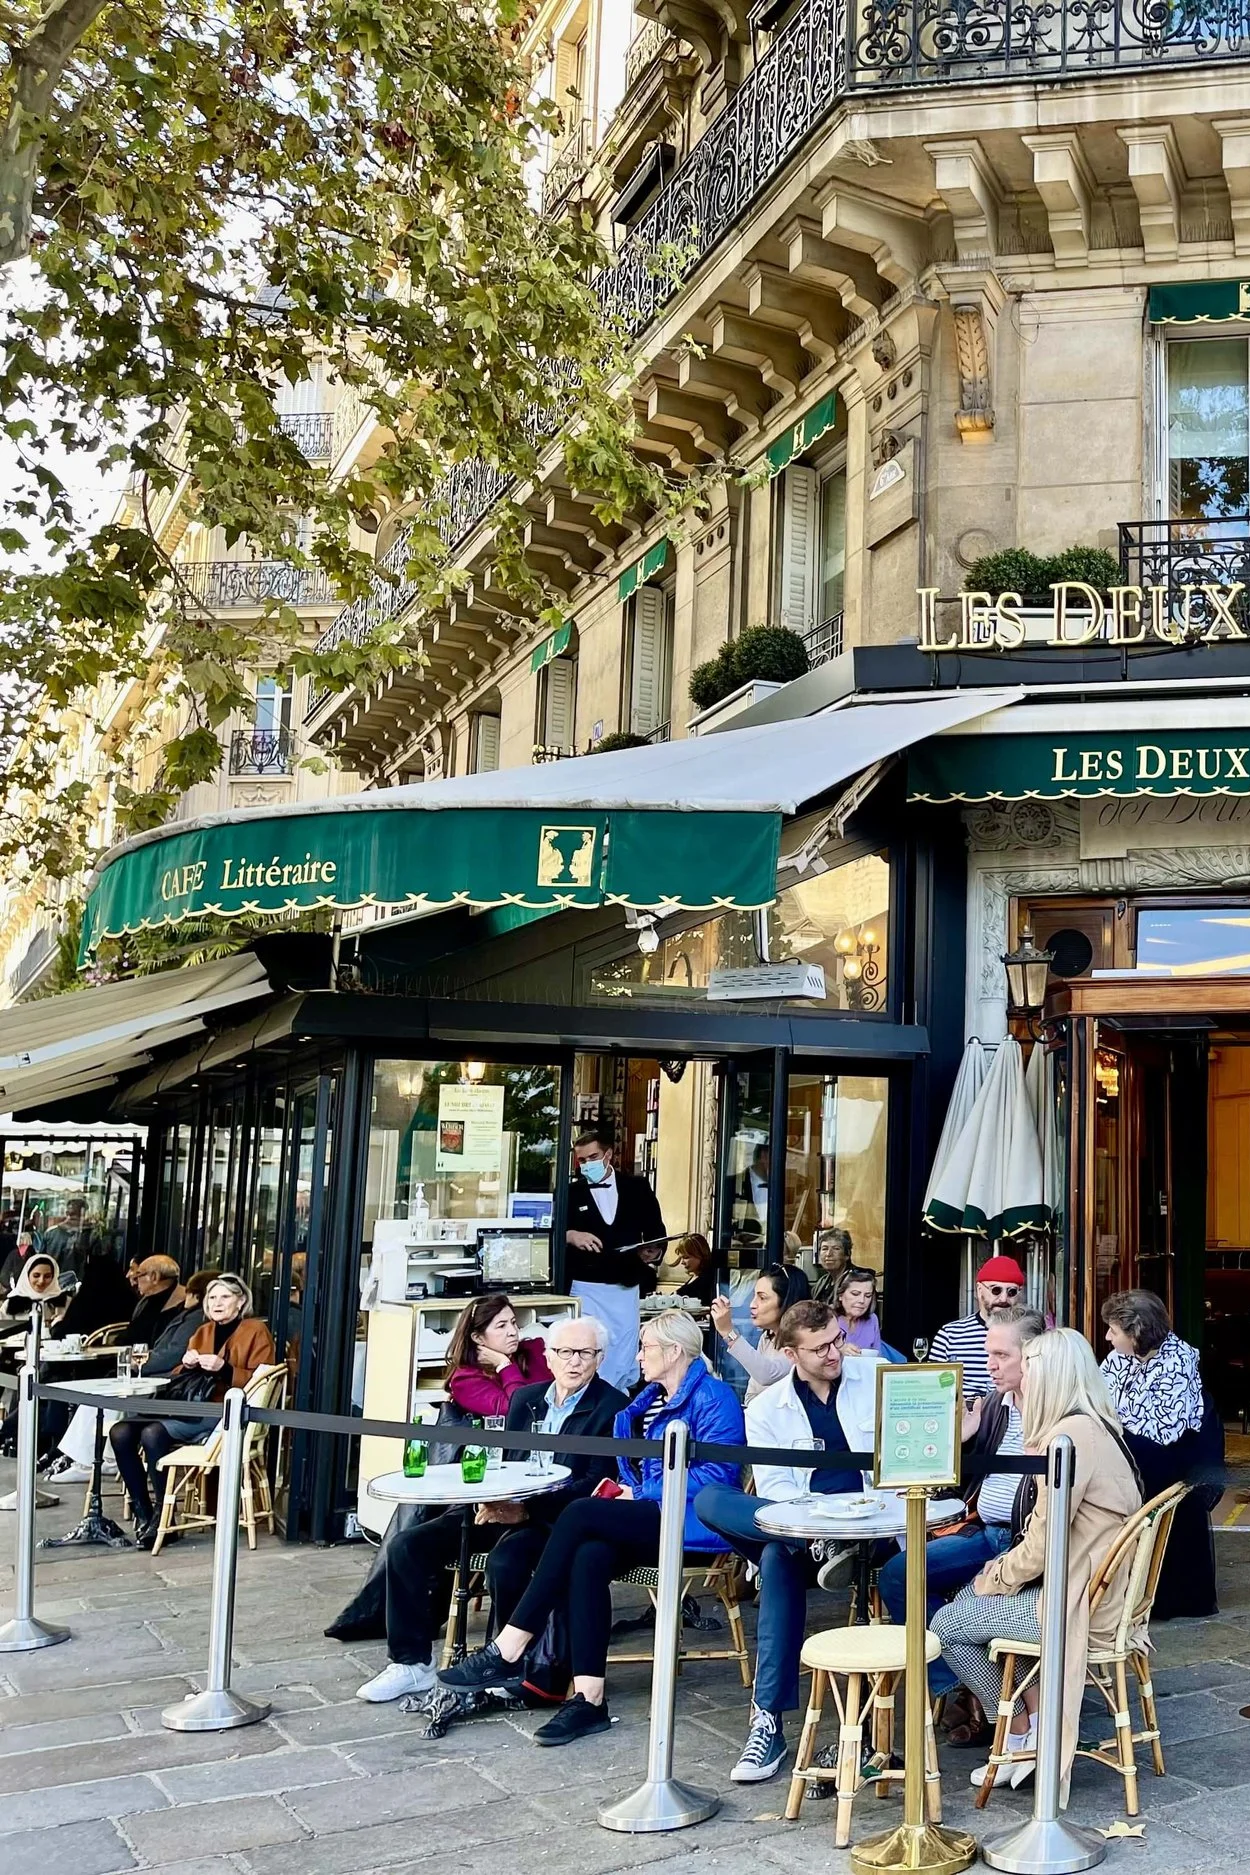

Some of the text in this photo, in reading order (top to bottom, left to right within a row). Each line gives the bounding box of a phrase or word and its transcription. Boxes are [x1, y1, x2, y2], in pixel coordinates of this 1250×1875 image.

[915, 586, 1026, 651] LES
[1047, 581, 1248, 646] DEUX
[1050, 747, 1124, 782] LES
[1135, 745, 1250, 780] DEUX
[219, 852, 337, 890] Littéraire
